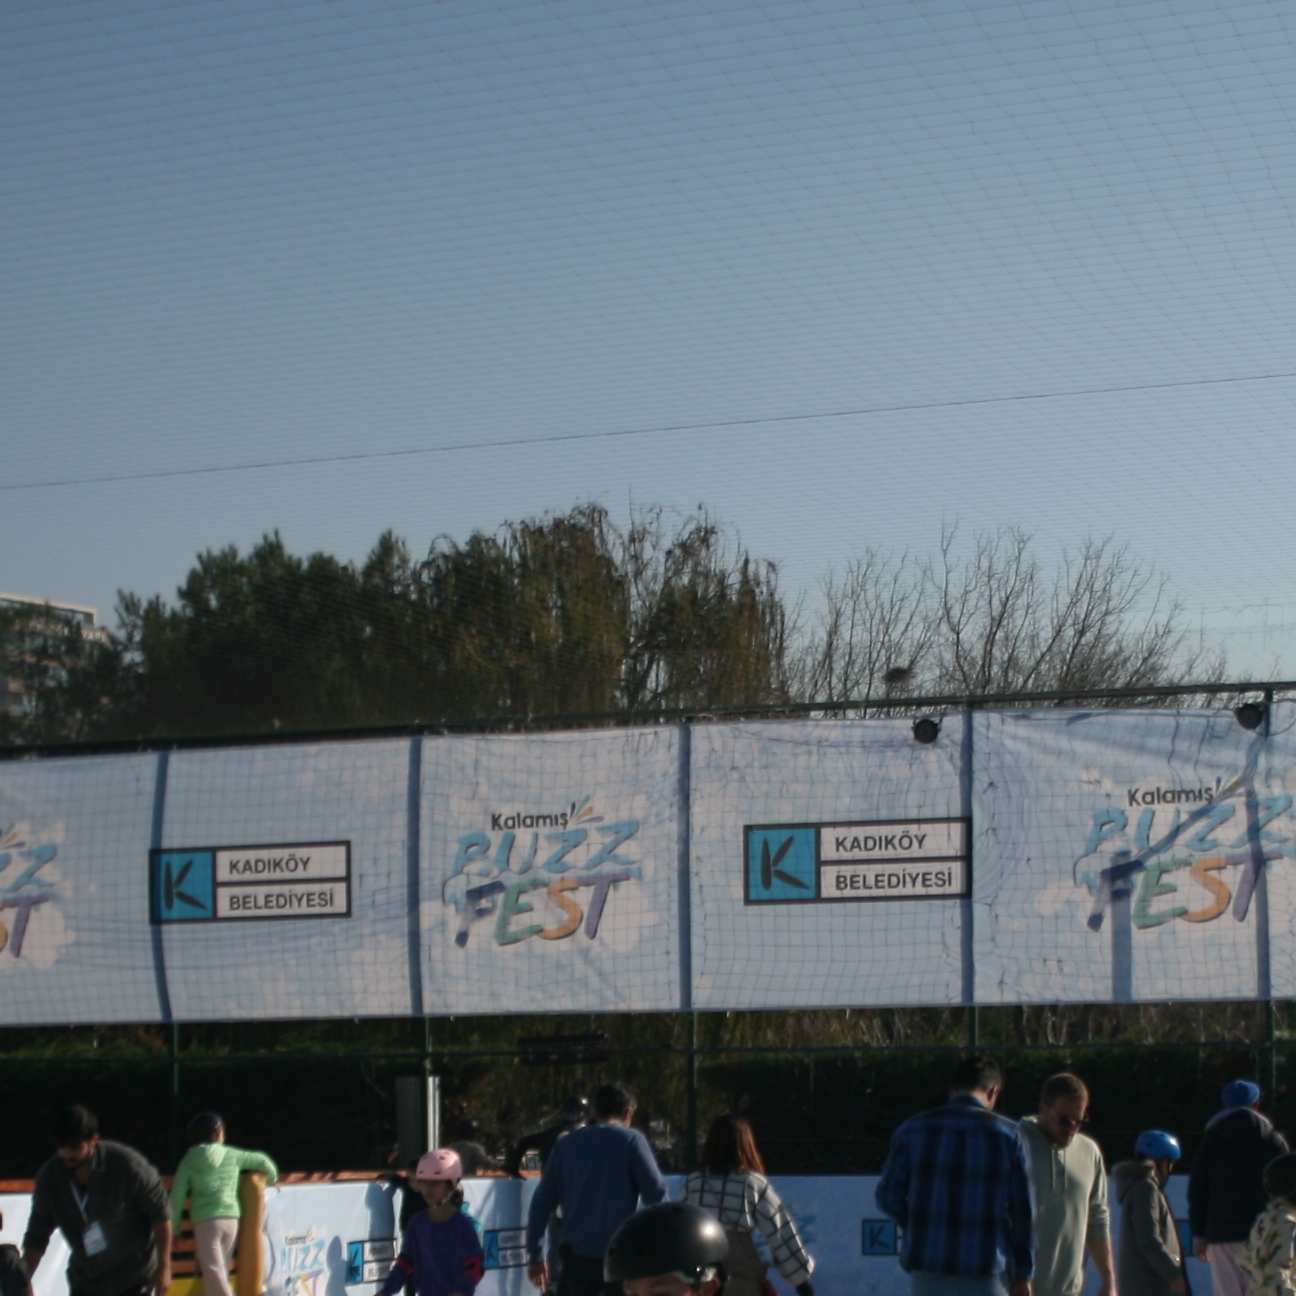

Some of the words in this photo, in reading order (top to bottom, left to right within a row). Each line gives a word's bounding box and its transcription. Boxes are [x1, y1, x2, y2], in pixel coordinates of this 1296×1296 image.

[1128, 786, 1214, 806] Kalamış
[491, 812, 568, 830] Kalamış
[835, 831, 927, 852] KADIKÖY
[229, 854, 311, 875] KADIKÖY
[835, 867, 953, 891] BELEDİYESİ
[229, 888, 334, 911] BELEDİYESİ
[1087, 851, 1284, 932] FEST
[455, 872, 630, 948] FEST
